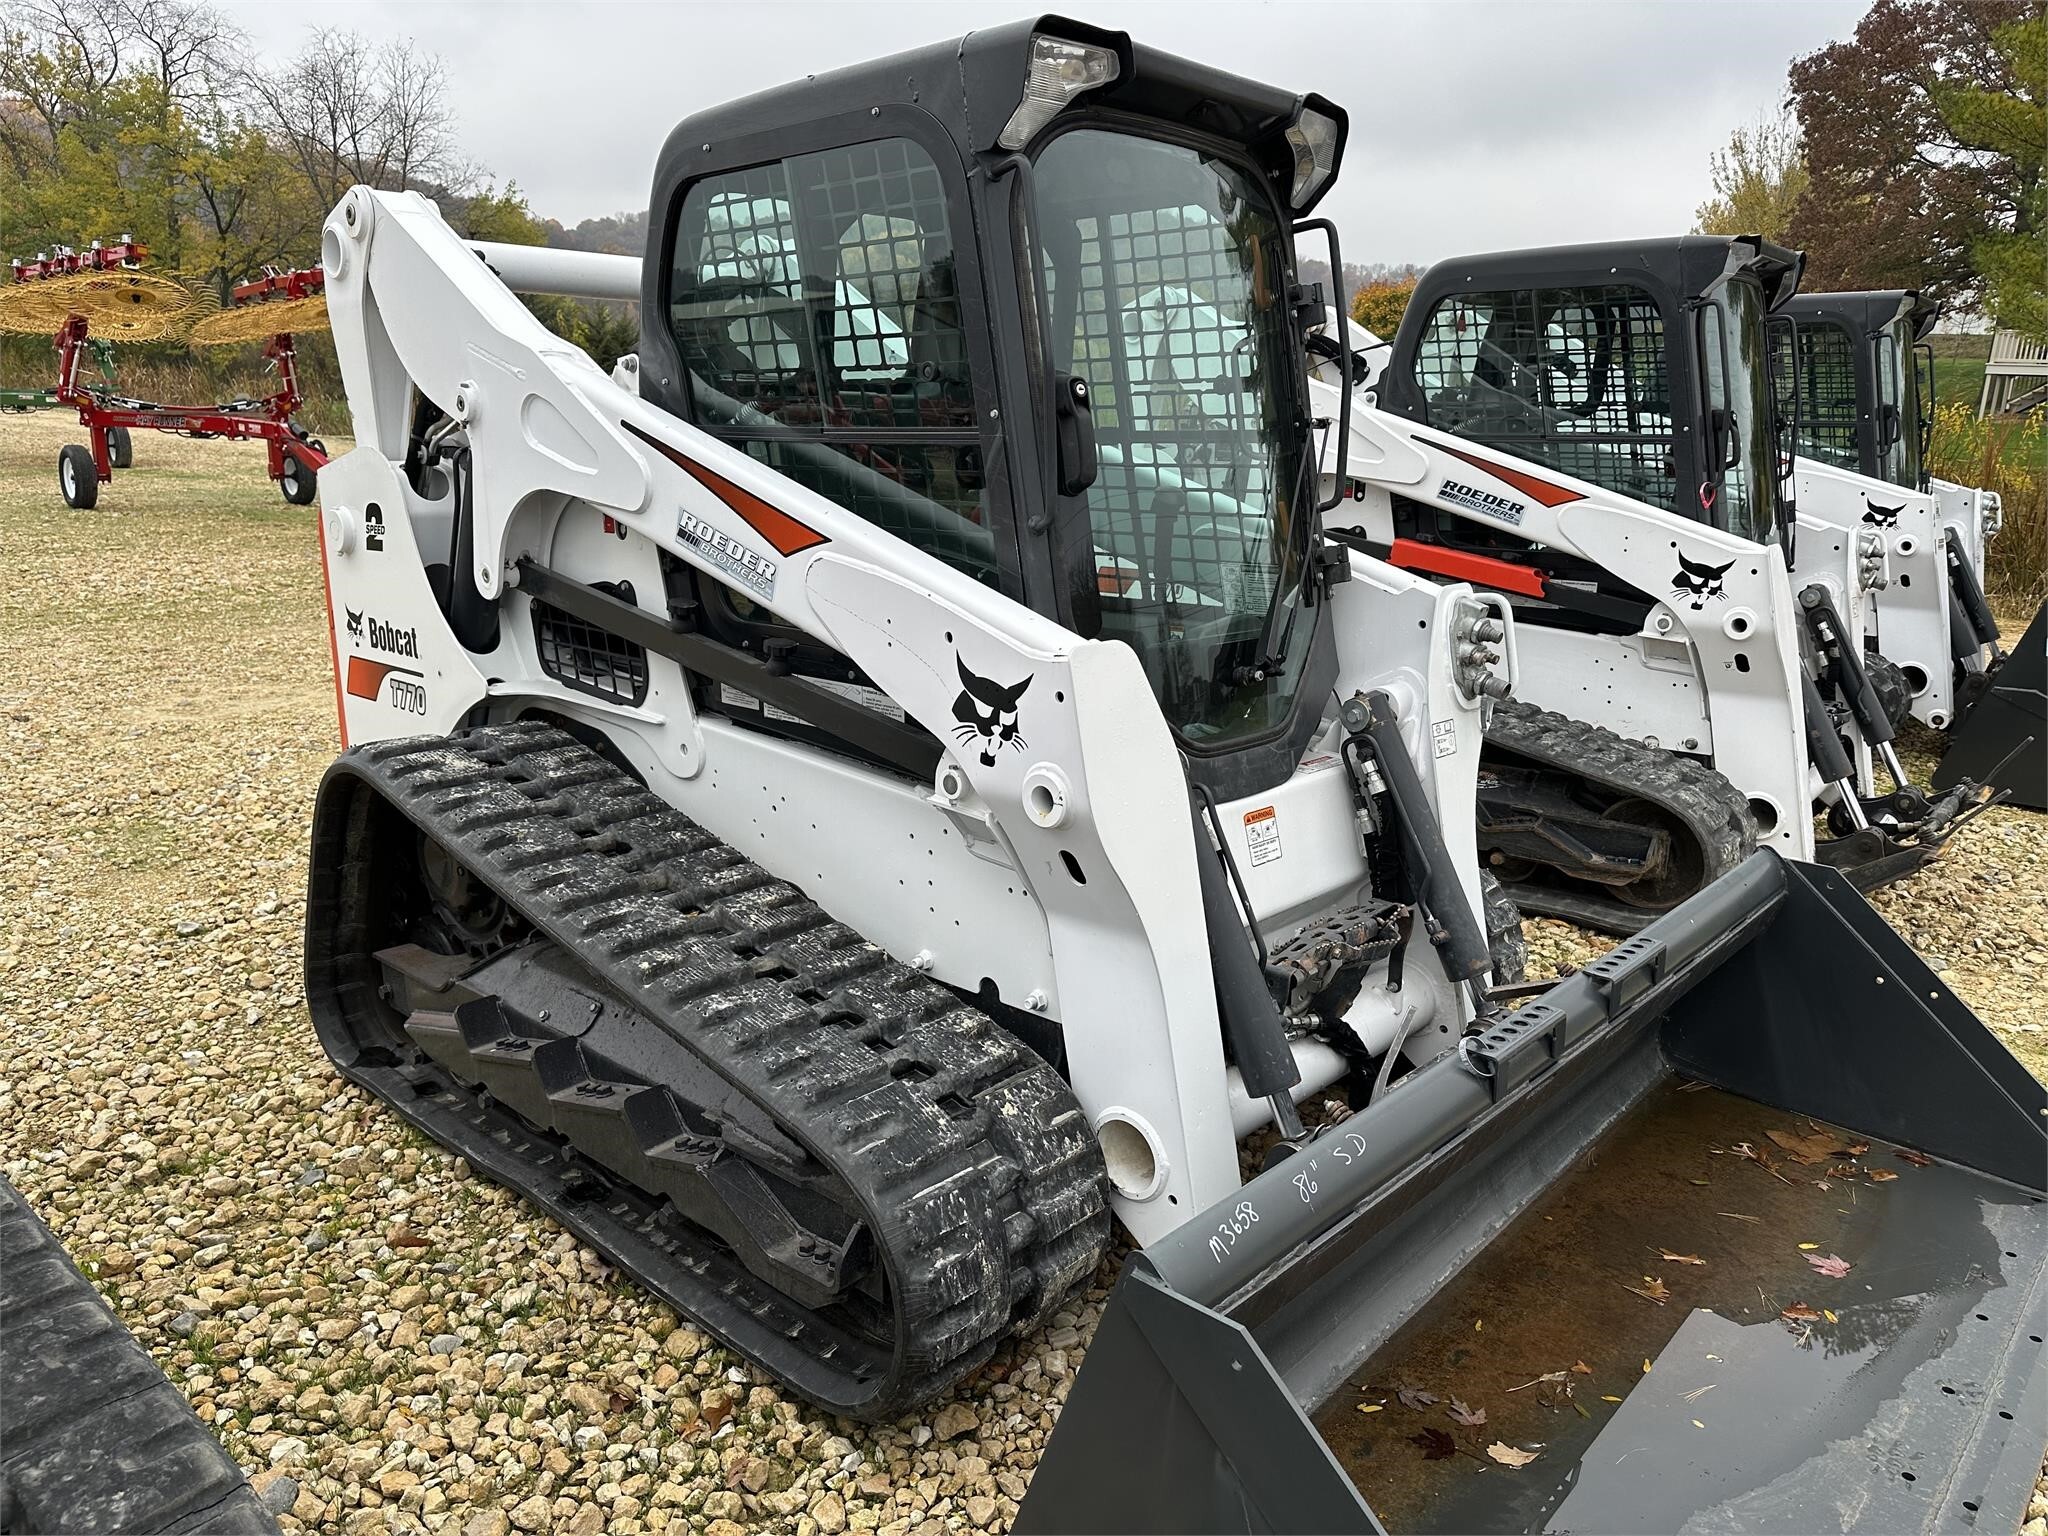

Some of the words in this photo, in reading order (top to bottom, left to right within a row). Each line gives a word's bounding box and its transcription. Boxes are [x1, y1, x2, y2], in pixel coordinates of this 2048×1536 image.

[154, 416, 186, 427] RUNNER
[1442, 479, 1525, 515] ROEDER
[1459, 496, 1516, 520] BROTHERS
[365, 502, 384, 552] 2
[365, 523, 386, 536] SPEED
[679, 509, 776, 583] ROEDER
[700, 541, 767, 589] BROTHERS
[368, 617, 419, 659] Bobcat
[389, 677, 427, 716] T770
[1251, 809, 1273, 820] WARNING
[1208, 1201, 1260, 1264] M3658
